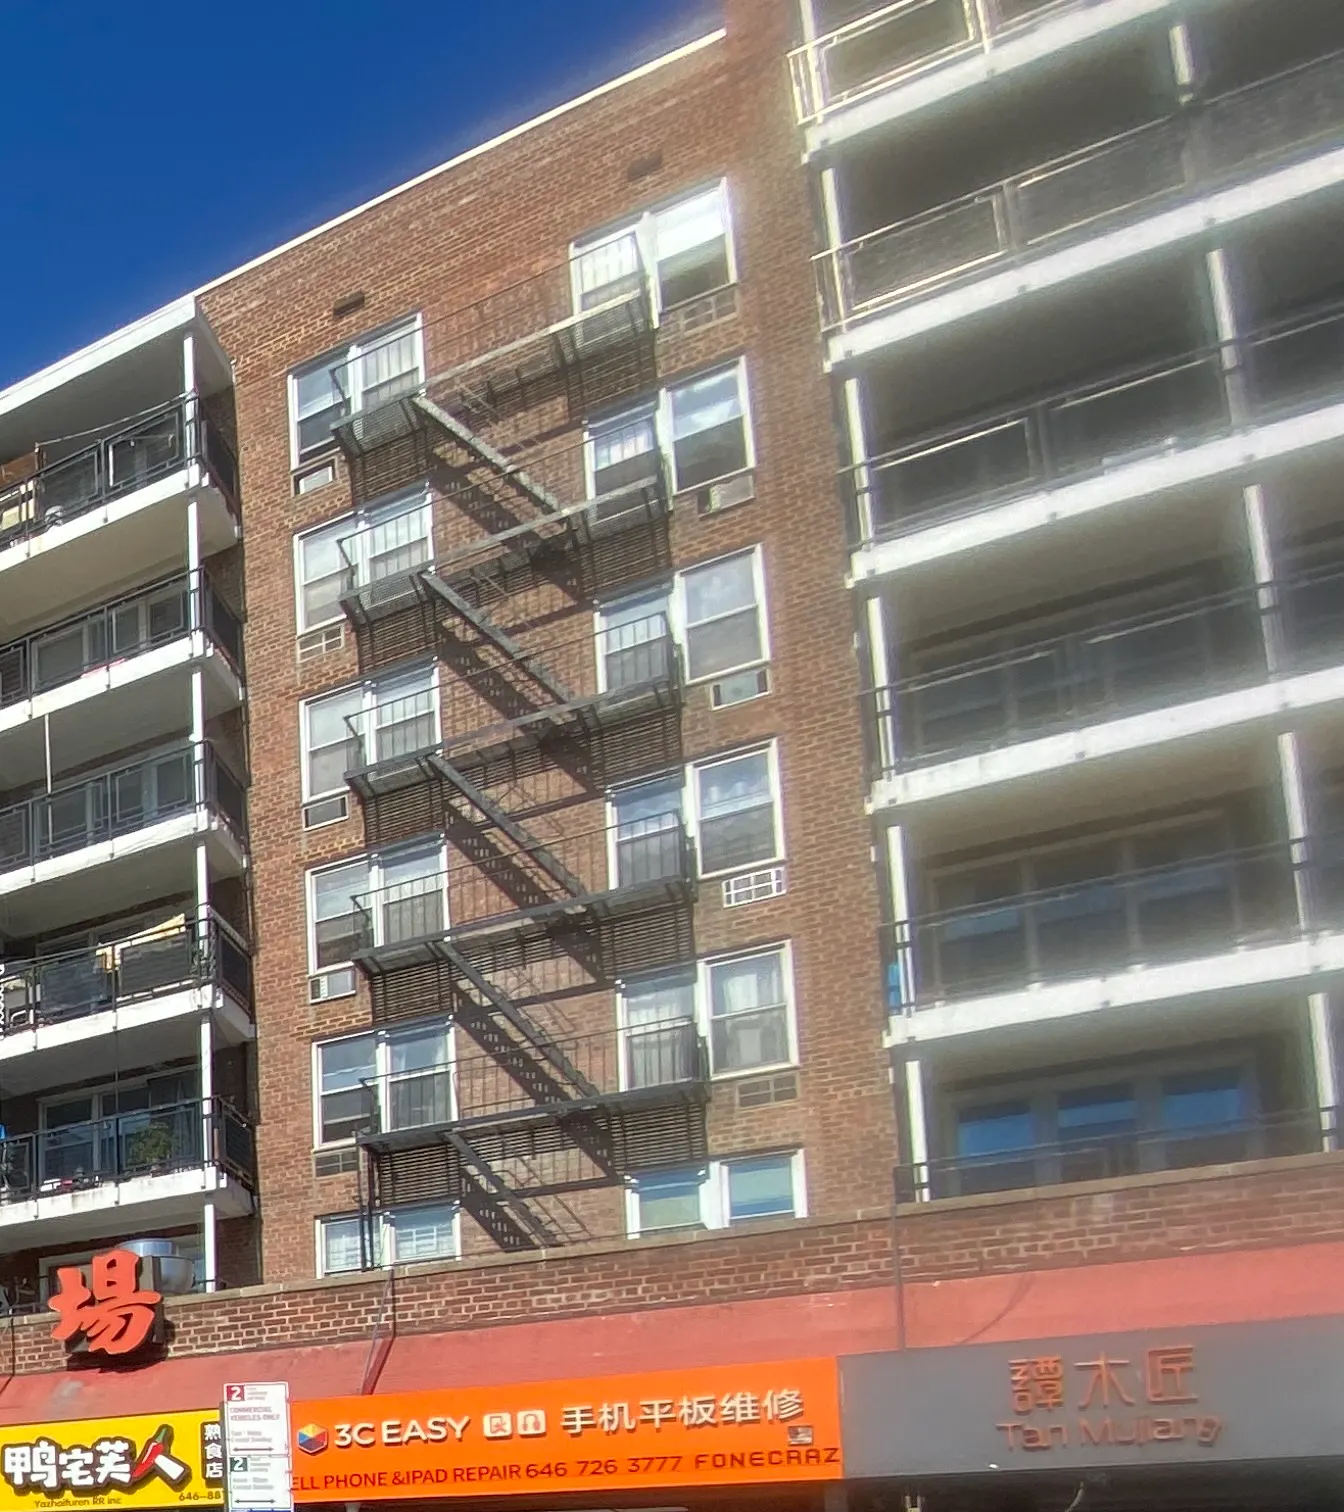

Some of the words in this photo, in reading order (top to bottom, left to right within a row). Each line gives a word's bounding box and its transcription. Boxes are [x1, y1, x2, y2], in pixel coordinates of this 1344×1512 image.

[1007, 1344, 1200, 1415] 譚木匠
[560, 1389, 805, 1437] 手机平板维修
[334, 1422, 376, 1448] 3C
[381, 1416, 472, 1445] EASY
[996, 1420, 1069, 1452] Tan
[1079, 1414, 1224, 1448] Mujiang
[291, 1475, 320, 1490] ELL
[324, 1471, 388, 1489] PHONE
[453, 1464, 522, 1483] REPAIR
[526, 1462, 568, 1478] 646
[577, 1459, 619, 1475] 726
[627, 1456, 683, 1472] 3777
[179, 1491, 221, 1502] 646-88
